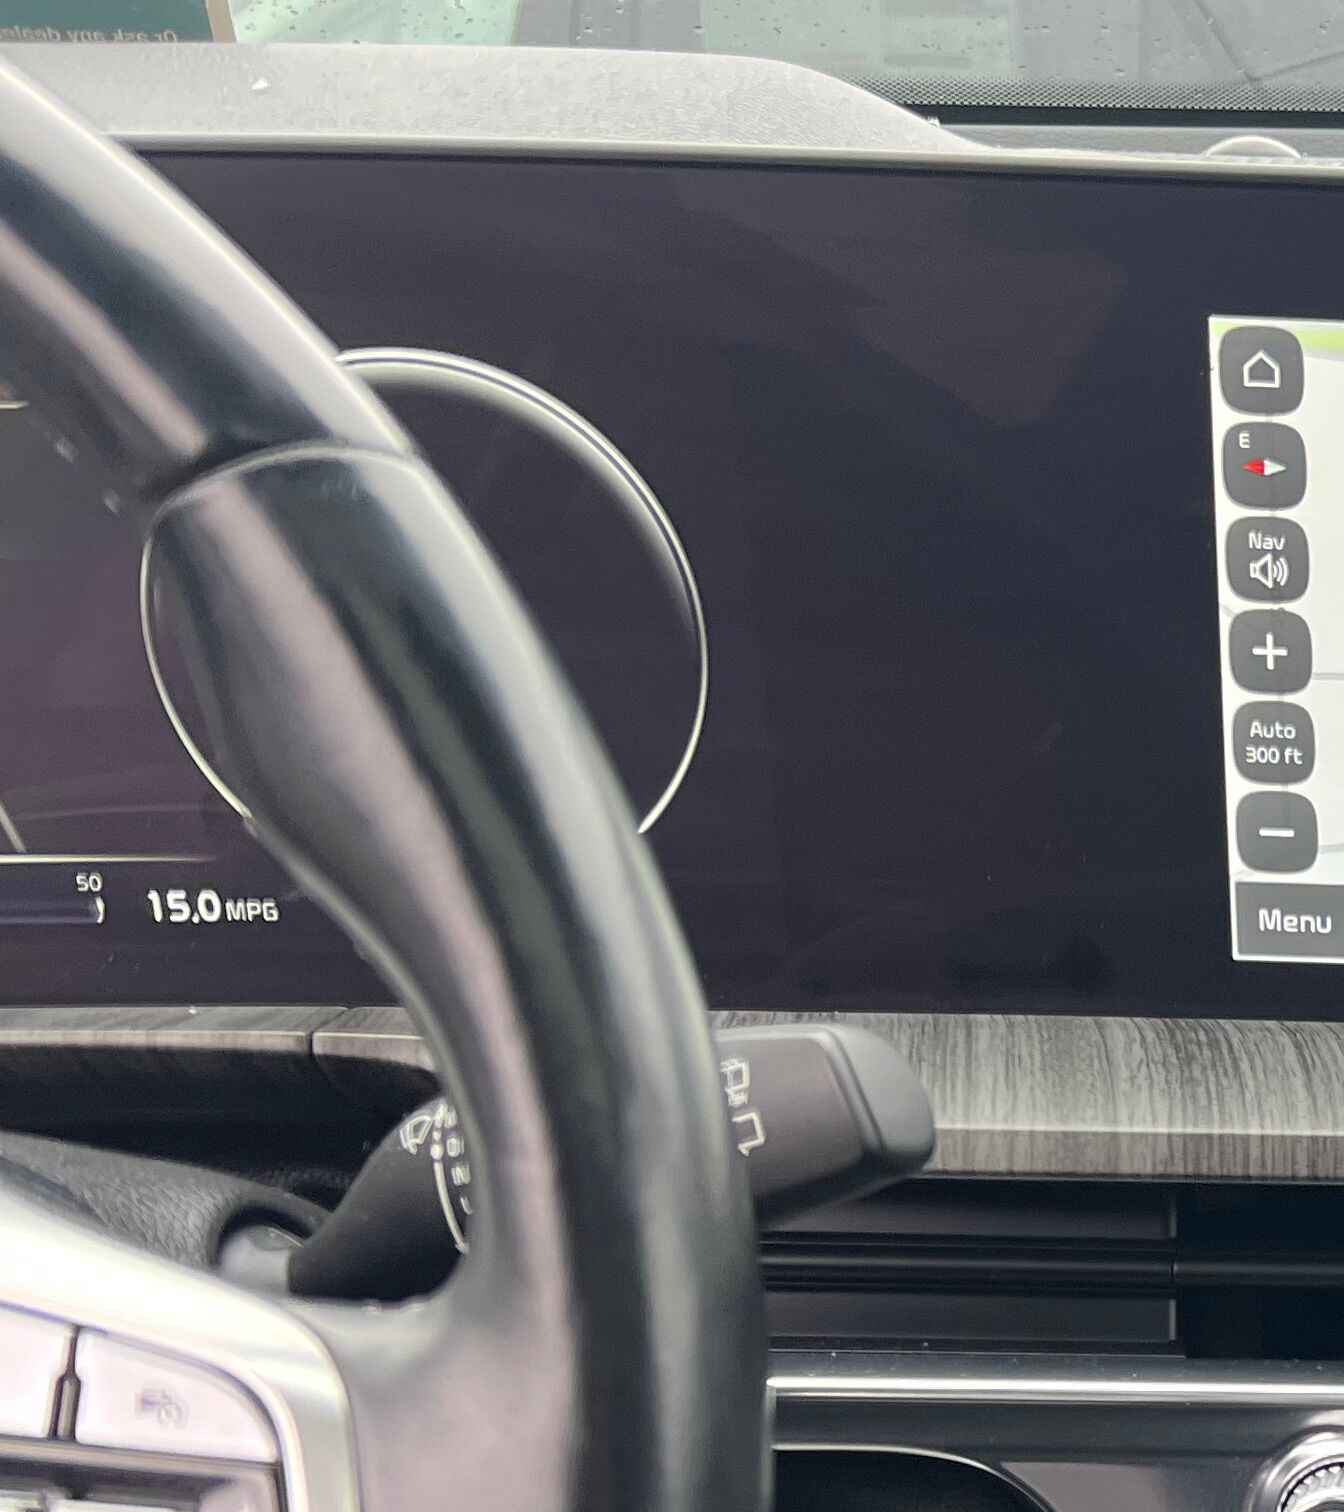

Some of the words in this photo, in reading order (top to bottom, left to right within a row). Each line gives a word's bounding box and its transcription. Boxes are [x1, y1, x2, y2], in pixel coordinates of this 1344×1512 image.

[1238, 433, 1251, 449] E
[1248, 532, 1285, 551] Nav
[1250, 720, 1296, 741] Auto
[1245, 746, 1279, 765] 300
[1283, 746, 1303, 766] ft
[76, 872, 103, 893] 50
[147, 889, 223, 924] 15.0
[225, 898, 280, 923] MPG
[1258, 908, 1332, 934] Menu
